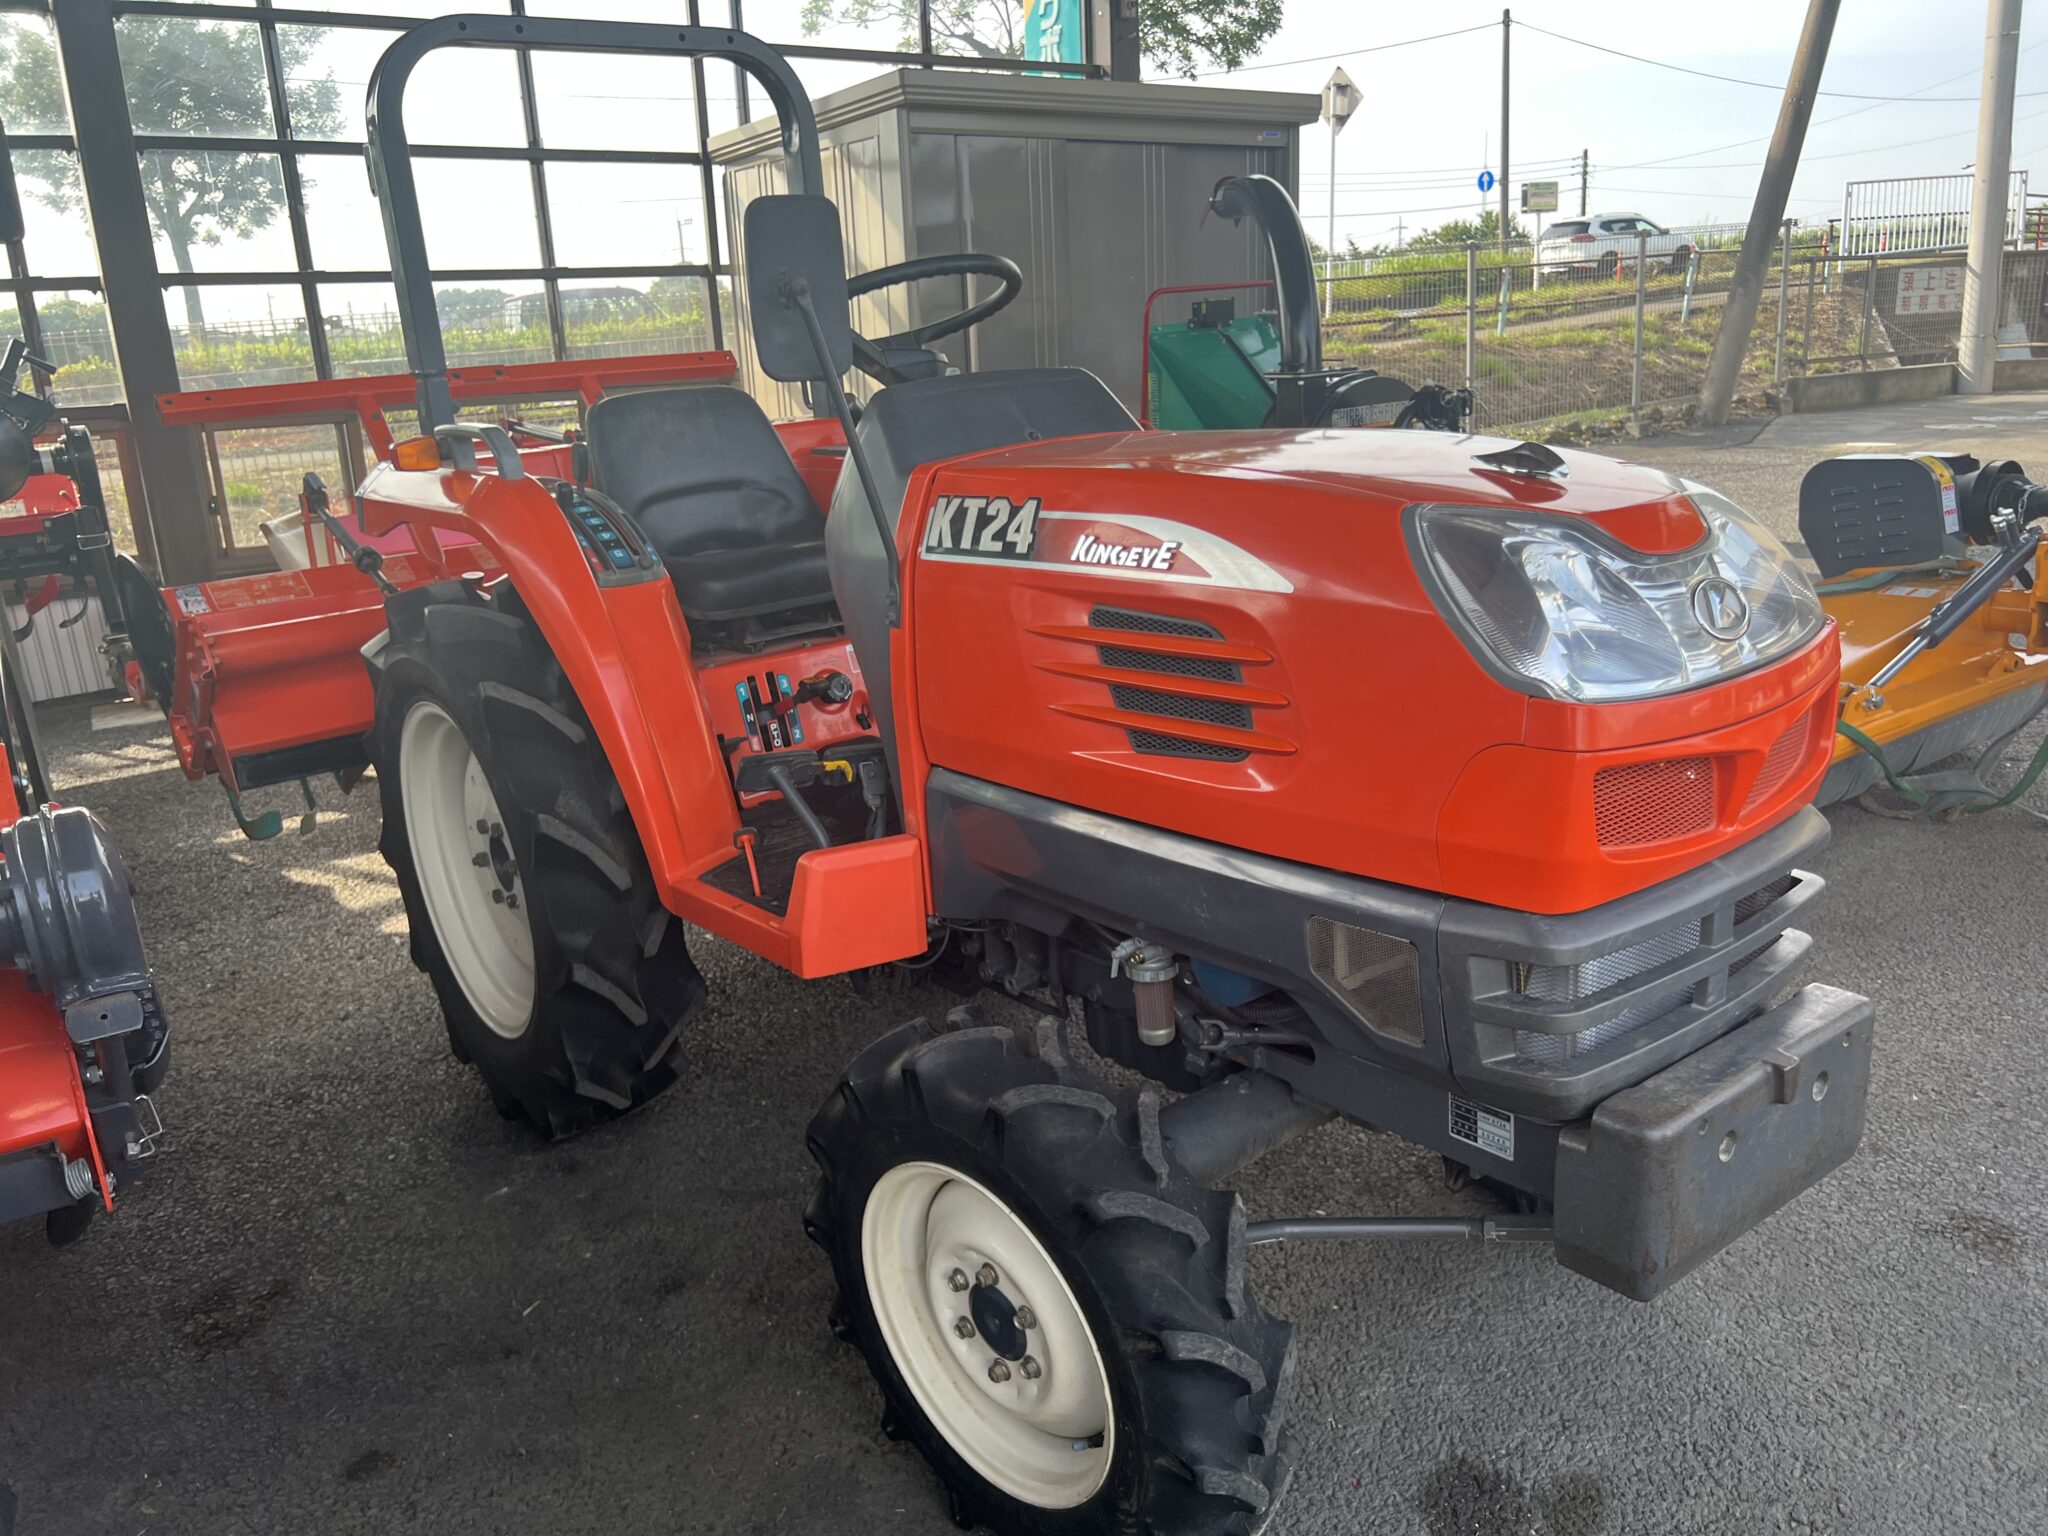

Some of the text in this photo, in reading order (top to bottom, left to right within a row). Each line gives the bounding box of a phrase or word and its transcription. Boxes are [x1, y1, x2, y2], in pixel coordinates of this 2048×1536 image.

[928, 497, 1038, 554] KT24
[746, 713, 754, 722] N
[770, 723, 782, 747] PTO
[794, 729, 801, 738] 2
